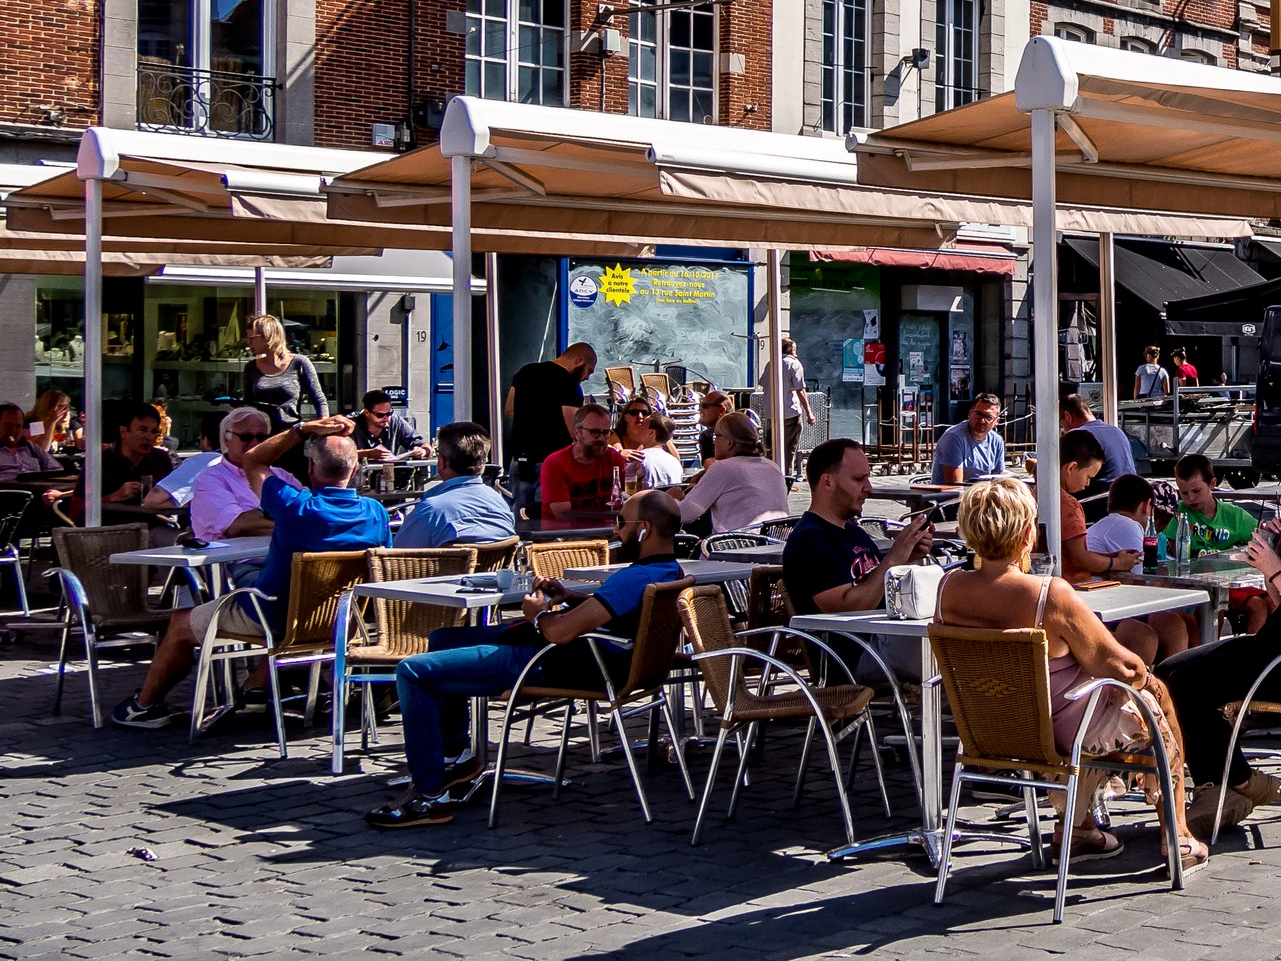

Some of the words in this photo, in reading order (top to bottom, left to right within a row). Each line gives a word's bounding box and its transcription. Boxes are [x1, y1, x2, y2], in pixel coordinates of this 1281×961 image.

[652, 278, 705, 288] Retrouvez-nous
[674, 289, 692, 297] Saint
[693, 290, 716, 298] Martin
[416, 330, 427, 343] 19
